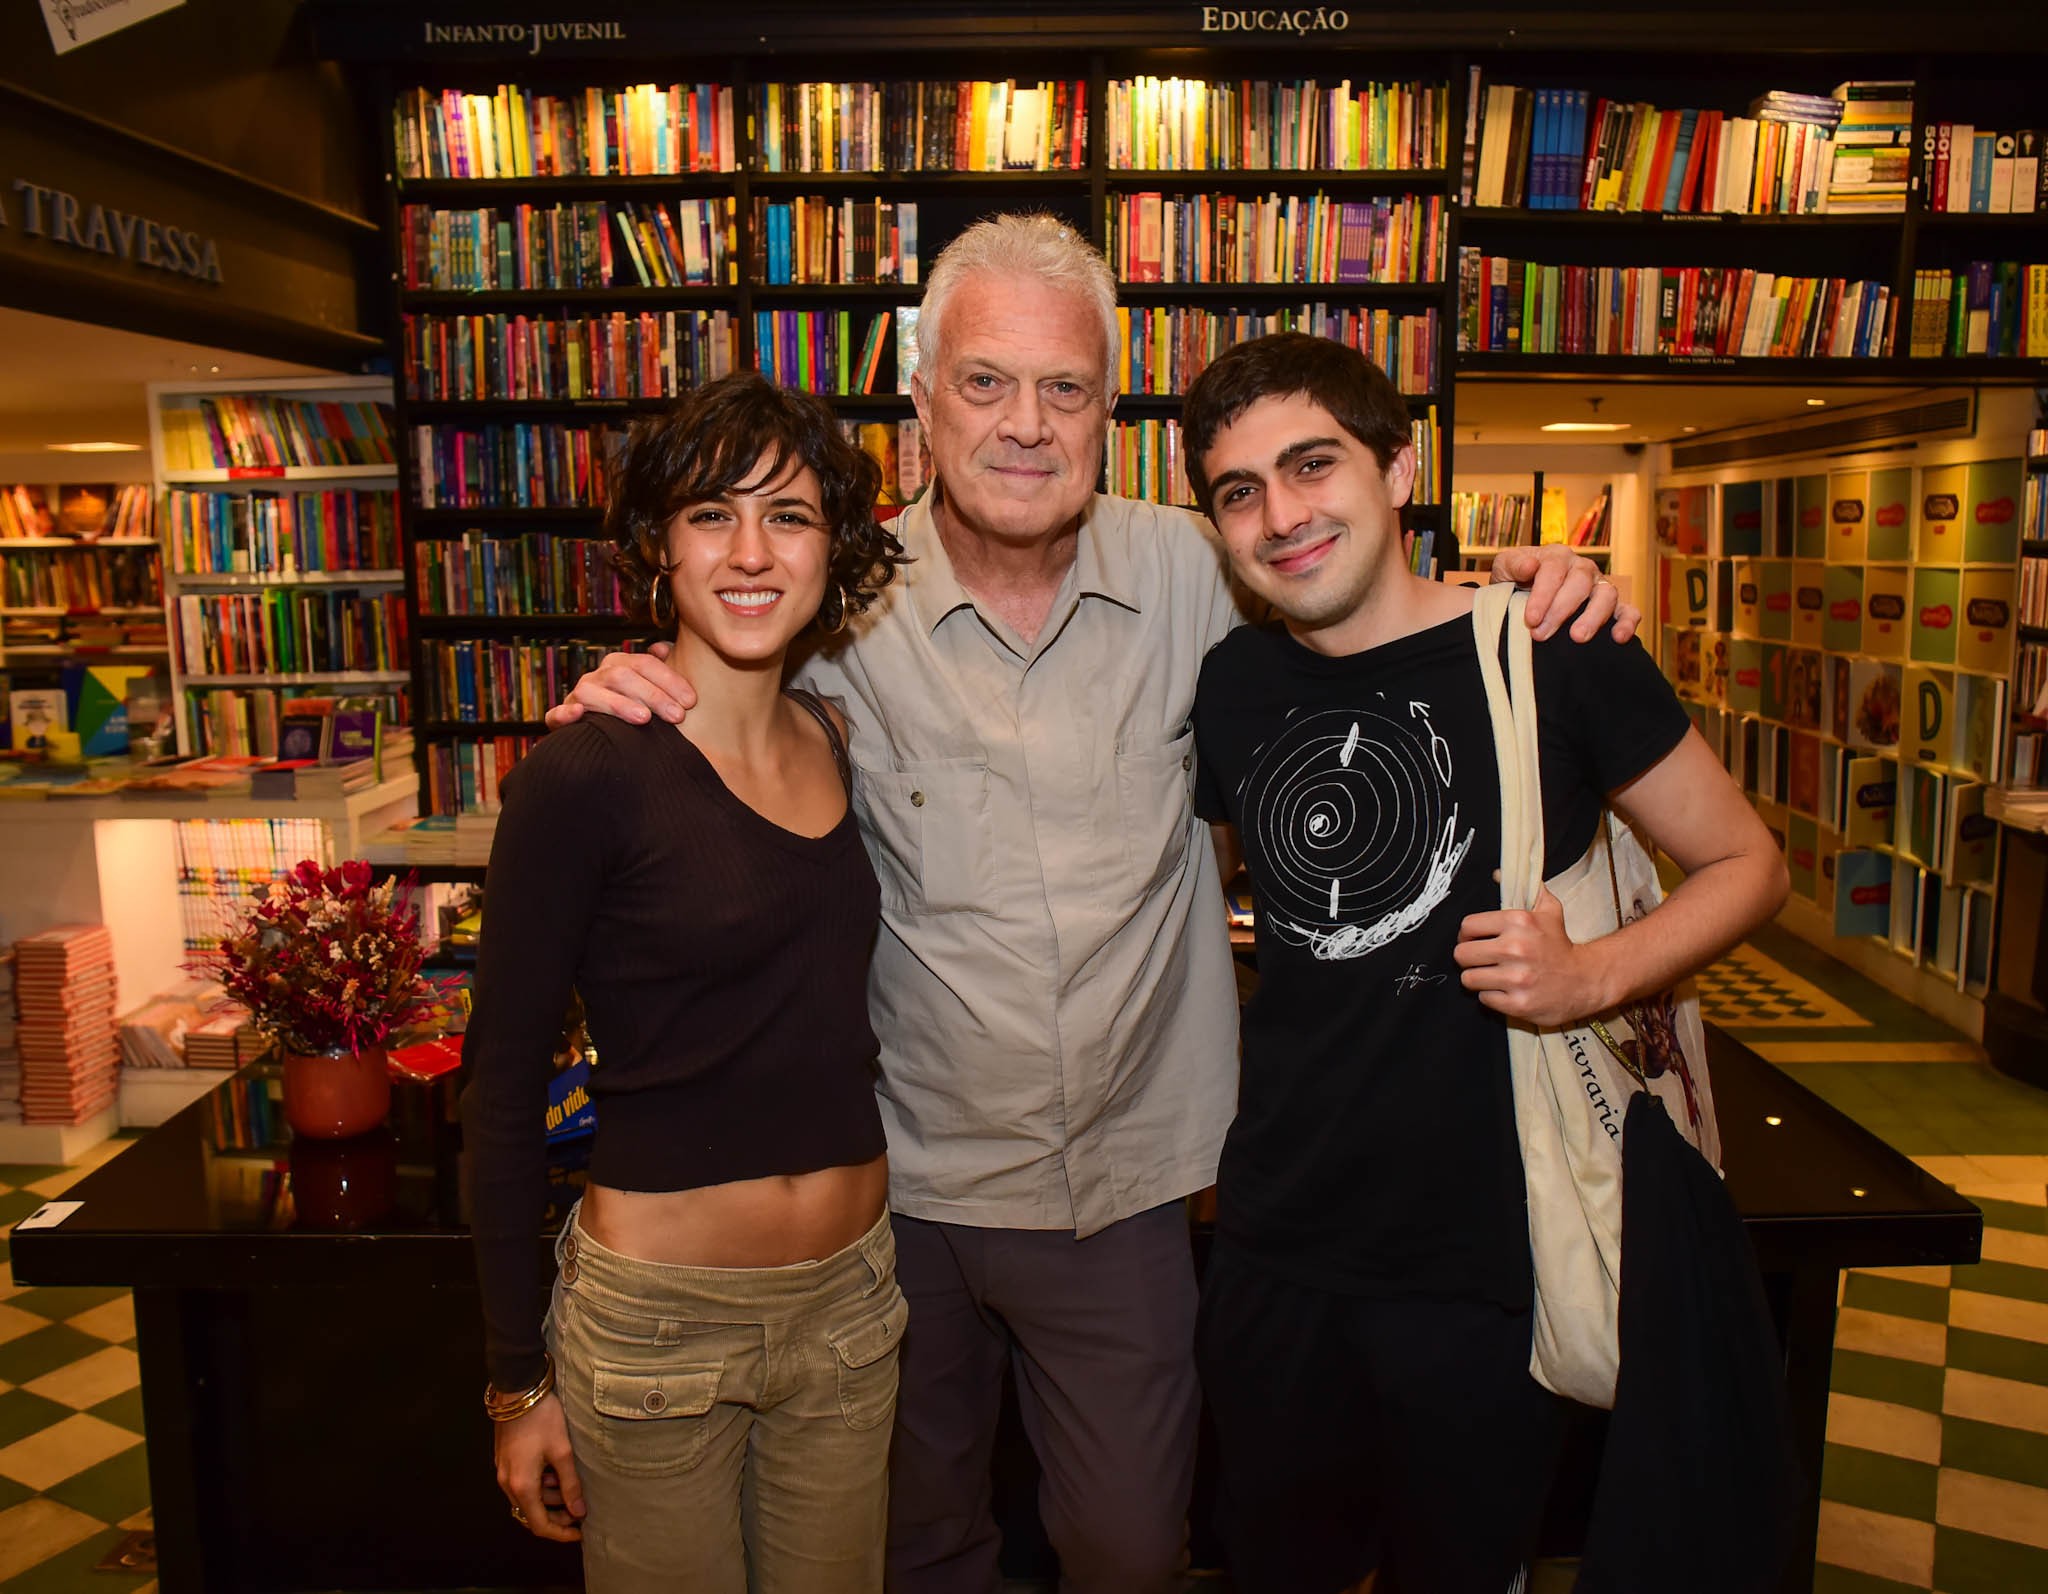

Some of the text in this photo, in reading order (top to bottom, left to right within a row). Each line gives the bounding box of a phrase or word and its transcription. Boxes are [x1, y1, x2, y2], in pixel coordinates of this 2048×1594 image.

[1201, 6, 1349, 36] EDUCAÇÃO
[1923, 125, 1937, 160] 501
[1937, 125, 1951, 160] 501
[13, 178, 225, 283] TRAVESSA
[1562, 1031, 1621, 1142] ivraria
[545, 1105, 563, 1131] da
